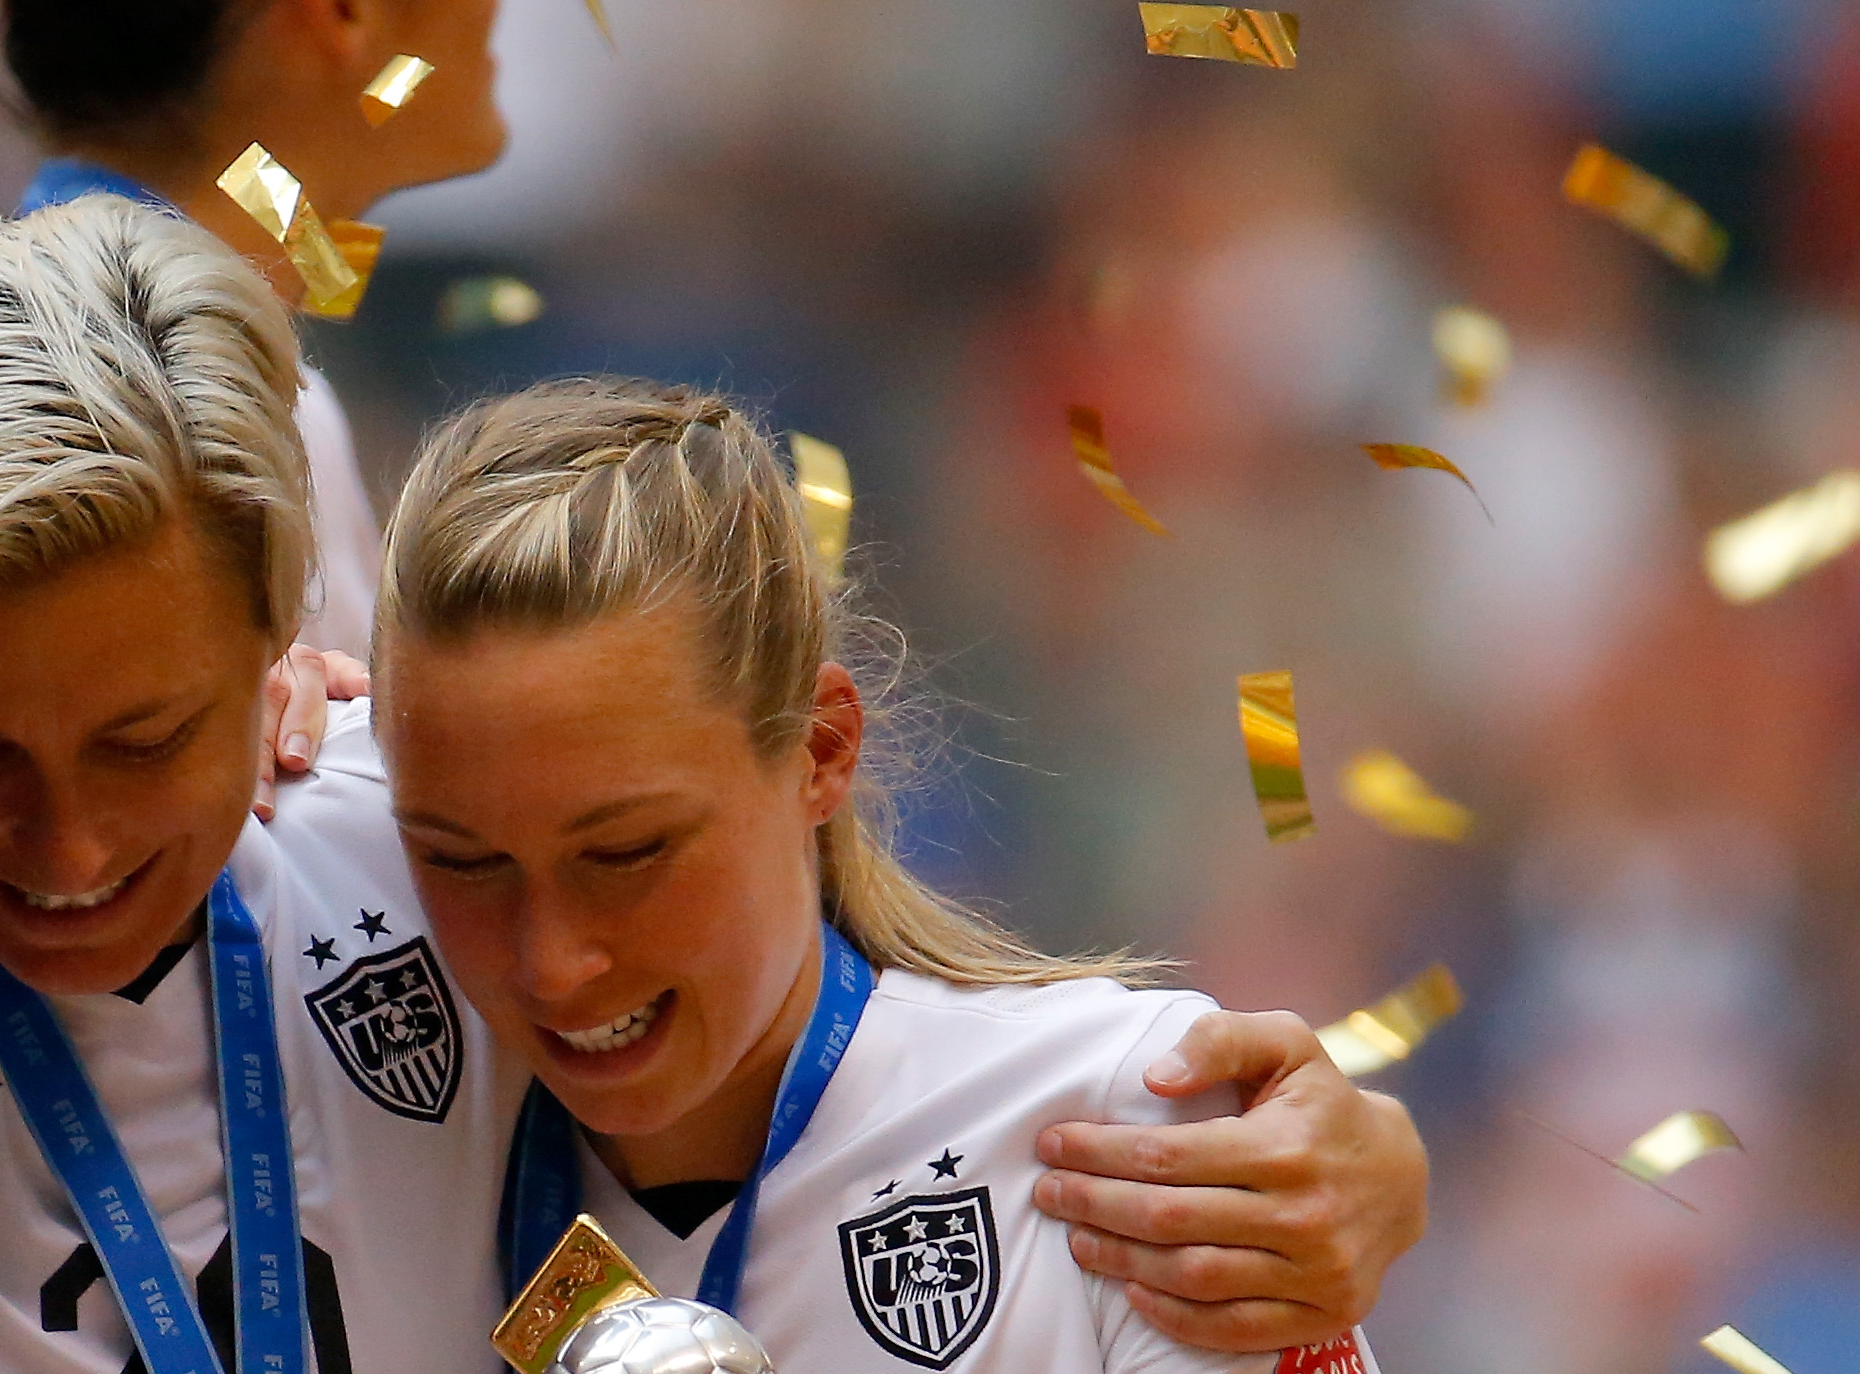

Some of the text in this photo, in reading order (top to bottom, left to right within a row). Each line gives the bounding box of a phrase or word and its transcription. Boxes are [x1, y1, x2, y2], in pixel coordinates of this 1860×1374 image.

[234, 953, 255, 1011] FIFA
[818, 1020, 851, 1073] FIFA
[243, 1052, 264, 1110] FIFA
[52, 1099, 91, 1155] FIFA
[251, 1152, 273, 1211] FIFA
[97, 1185, 135, 1243] FIFA
[140, 1276, 176, 1336] FIFA
[259, 1253, 281, 1312] FIFA
